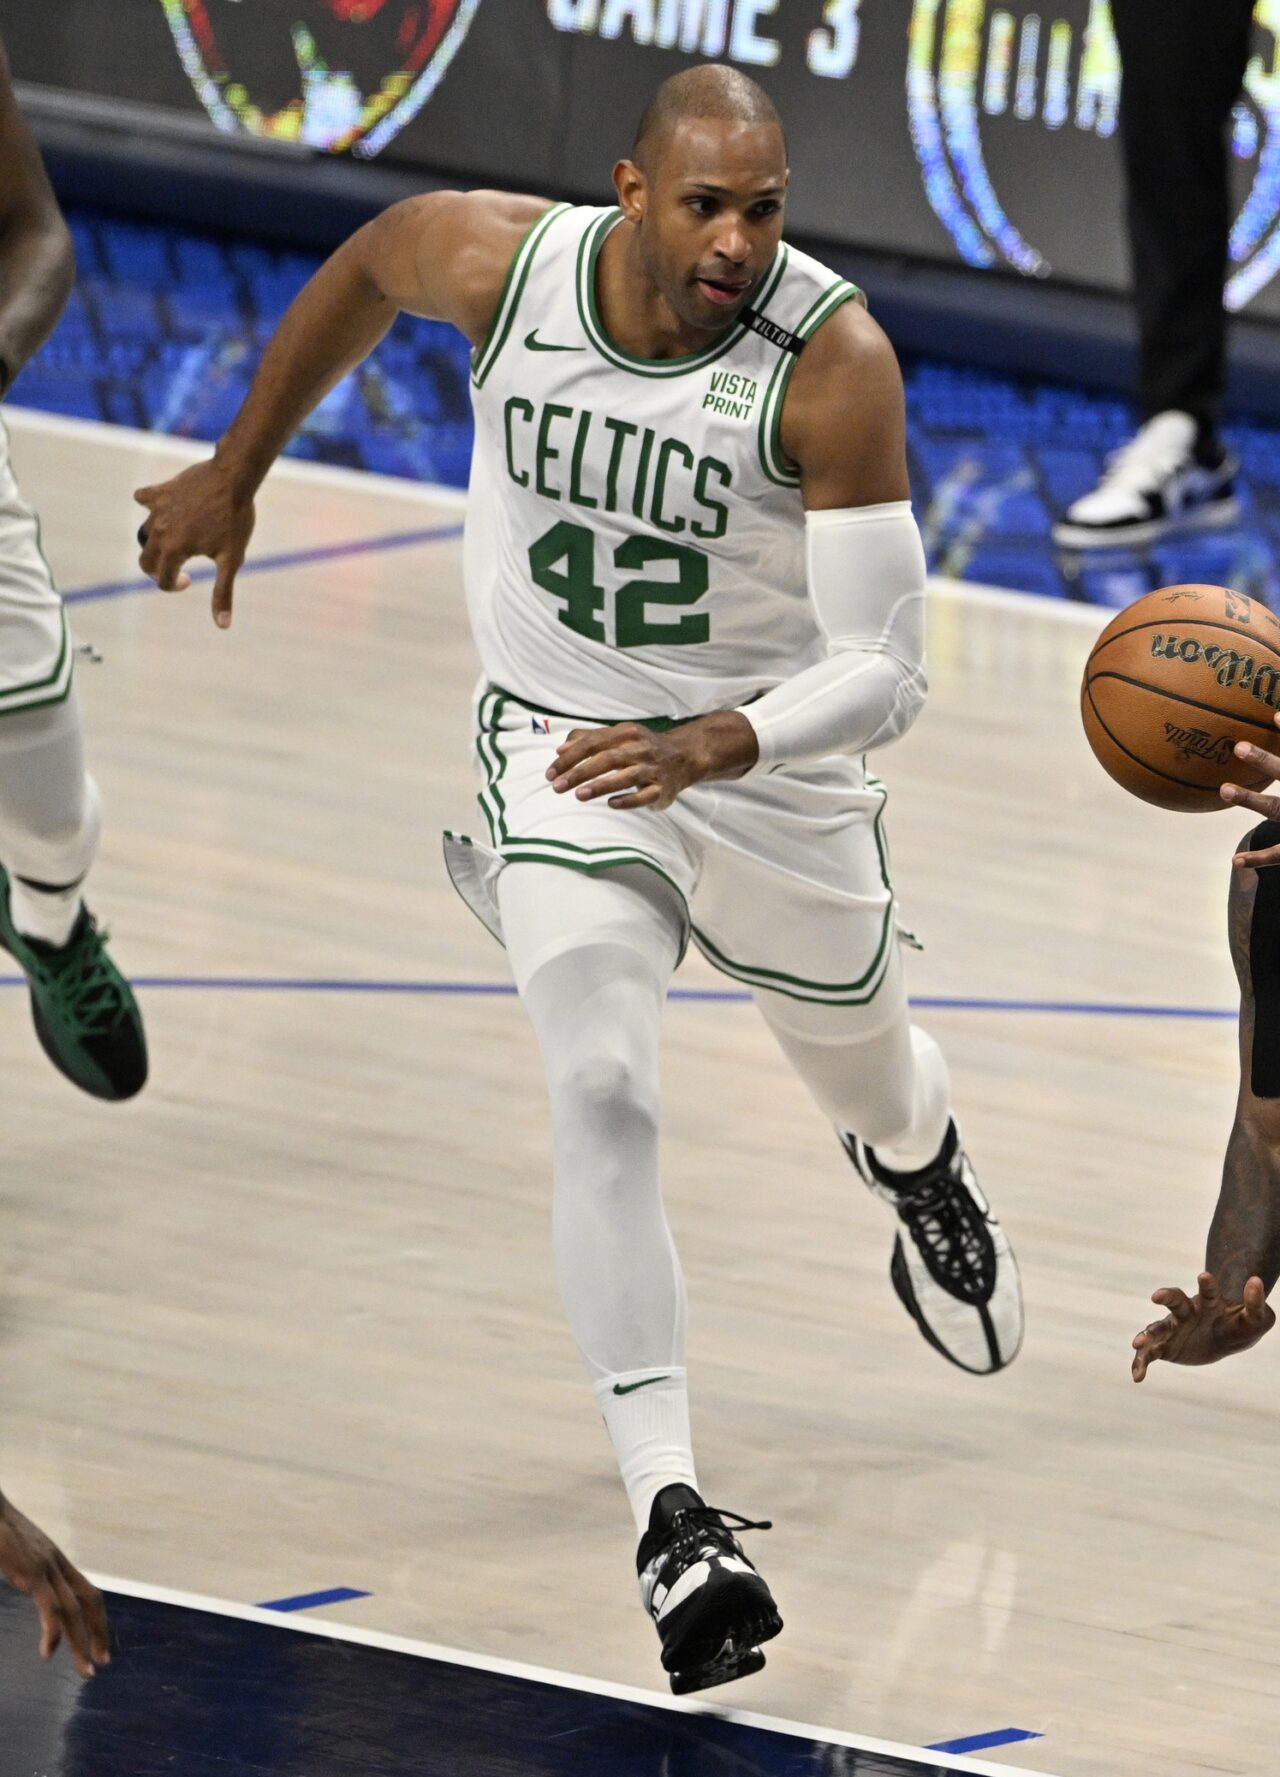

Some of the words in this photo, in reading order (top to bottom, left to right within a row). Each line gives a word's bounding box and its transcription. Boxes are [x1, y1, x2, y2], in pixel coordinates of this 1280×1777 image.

[751, 315, 793, 347] WALTON
[708, 371, 758, 404] VISTA
[702, 393, 752, 421] PRINT
[503, 396, 733, 539] CELTICS
[528, 520, 710, 648] 42
